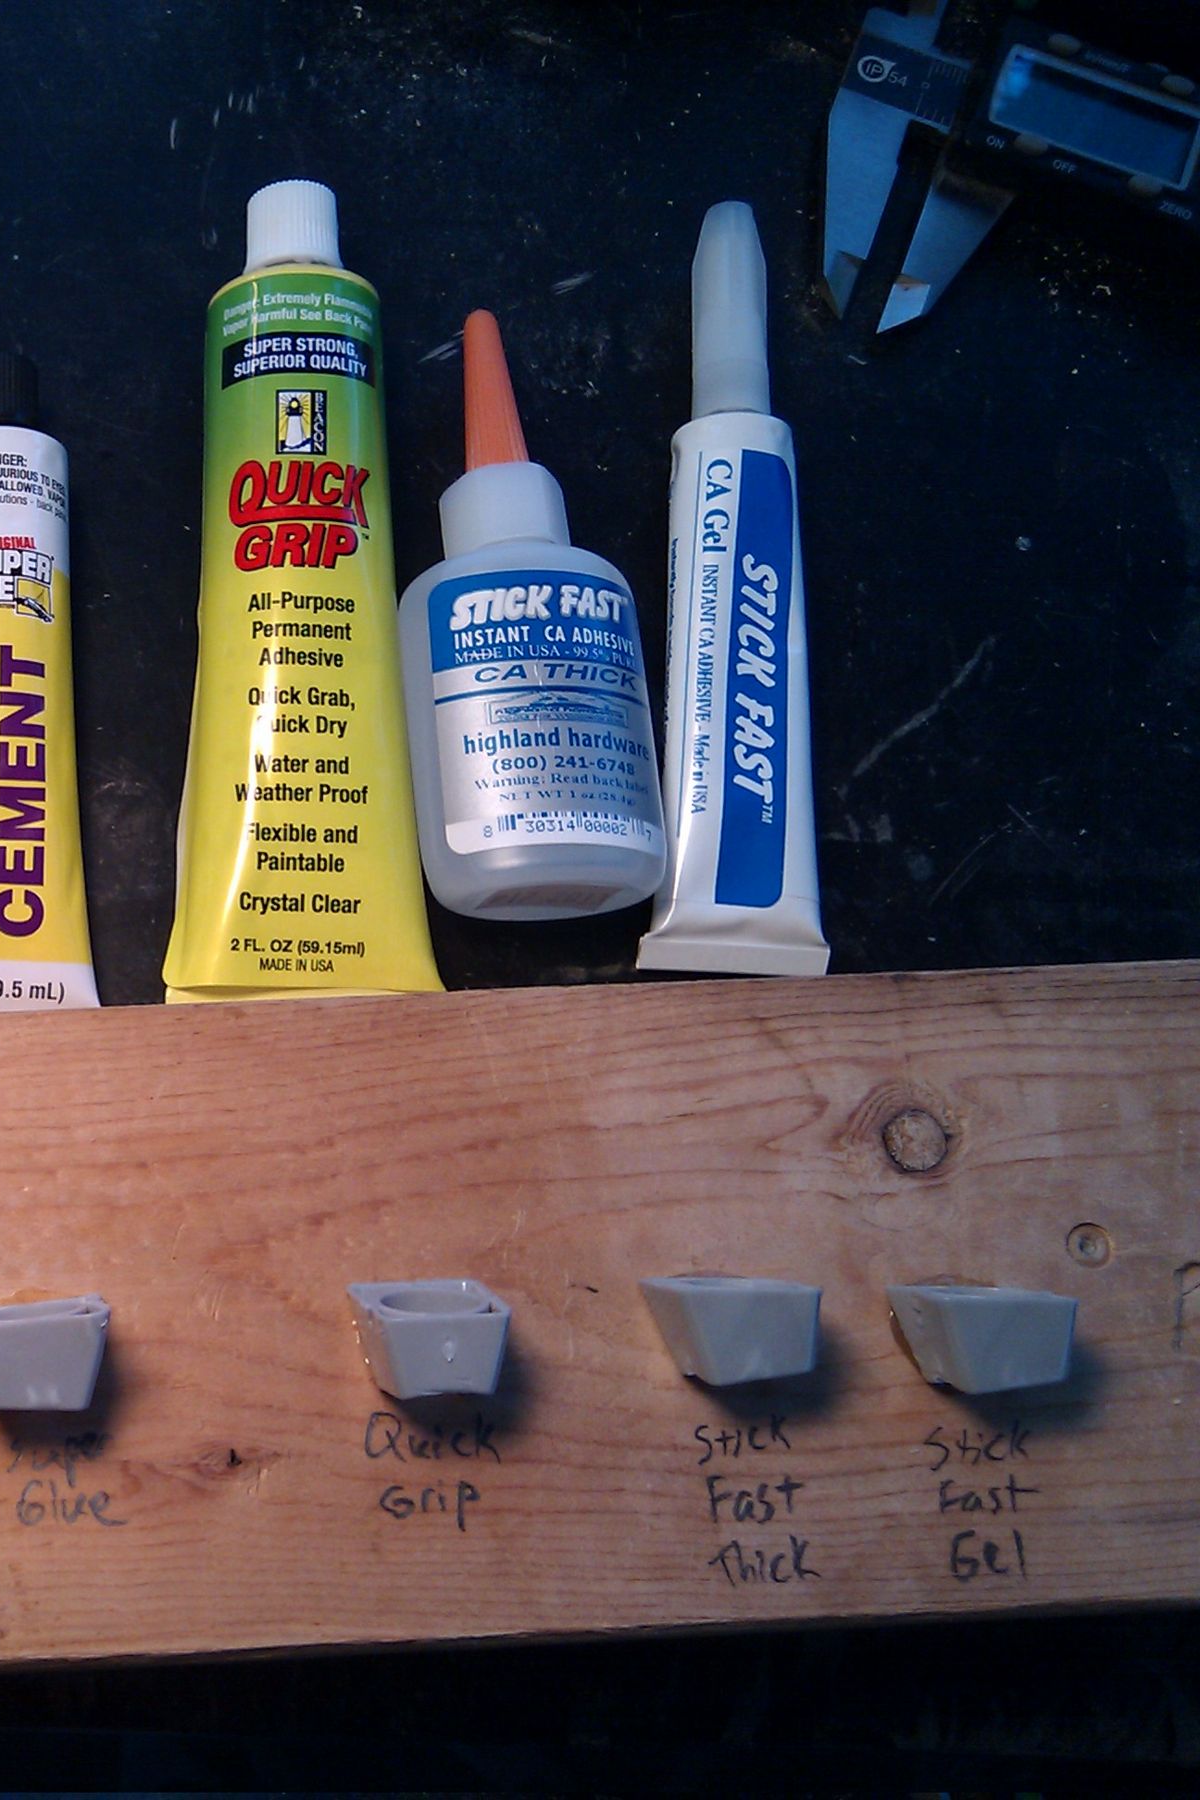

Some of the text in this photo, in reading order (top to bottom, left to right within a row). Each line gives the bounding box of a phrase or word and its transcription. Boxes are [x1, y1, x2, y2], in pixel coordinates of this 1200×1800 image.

[887, 71, 908, 87] 54
[985, 134, 1006, 150] ON
[1052, 158, 1078, 175] OFF
[1158, 200, 1193, 220] ZERO
[263, 293, 321, 307] Extremely
[223, 308, 352, 336] Vapor Harmful See Back
[244, 337, 359, 359] SUPER STRONG,
[233, 354, 367, 378] SUPERIOR QUALITY
[313, 392, 325, 452] BEACON
[40, 473, 51, 486] TO
[229, 460, 370, 529] QUICK
[234, 522, 358, 572] GRIP
[248, 591, 356, 614] All-Purpose
[449, 585, 553, 631] STICK
[560, 584, 624, 624] FAST
[252, 620, 352, 641] Permanent
[454, 625, 635, 657] INSTANT CA ADHESIVE
[691, 458, 734, 814] CA Gel INSTANT CA ADHESIVE Made in USA
[259, 646, 344, 668] Adhesive
[454, 644, 561, 665] MADE IN USA
[474, 663, 637, 692] CA THICK
[733, 553, 779, 806] STICK FAST
[248, 686, 356, 711] Qick Grab,
[257, 714, 348, 738] uick Dry
[463, 726, 651, 761] highland hardware
[254, 754, 349, 774] Water and
[492, 755, 636, 776] (800) 241-6748
[474, 774, 545, 790] Warning:
[550, 772, 590, 785] Read
[592, 774, 623, 788] back
[234, 783, 368, 804] Weather Proof
[248, 822, 358, 844] Flexible and
[483, 825, 493, 838] 8
[524, 819, 576, 834] 30314
[256, 851, 345, 873] Paintable
[239, 891, 362, 916] Crystal Clear
[230, 938, 366, 958] 2 FL. OZ (59.15ml)
[259, 957, 335, 973] MADE IN USA
[29, 982, 65, 1004] mL)
[364, 1411, 501, 1465] Quick
[694, 1413, 791, 1465] Stick
[922, 1420, 1031, 1471] Stick
[15, 1479, 130, 1528] Glue
[379, 1479, 481, 1532] Grip
[705, 1473, 806, 1524] Fast
[938, 1473, 1042, 1516] Fast
[707, 1534, 822, 1588] Thick
[951, 1529, 1028, 1583] Gel
